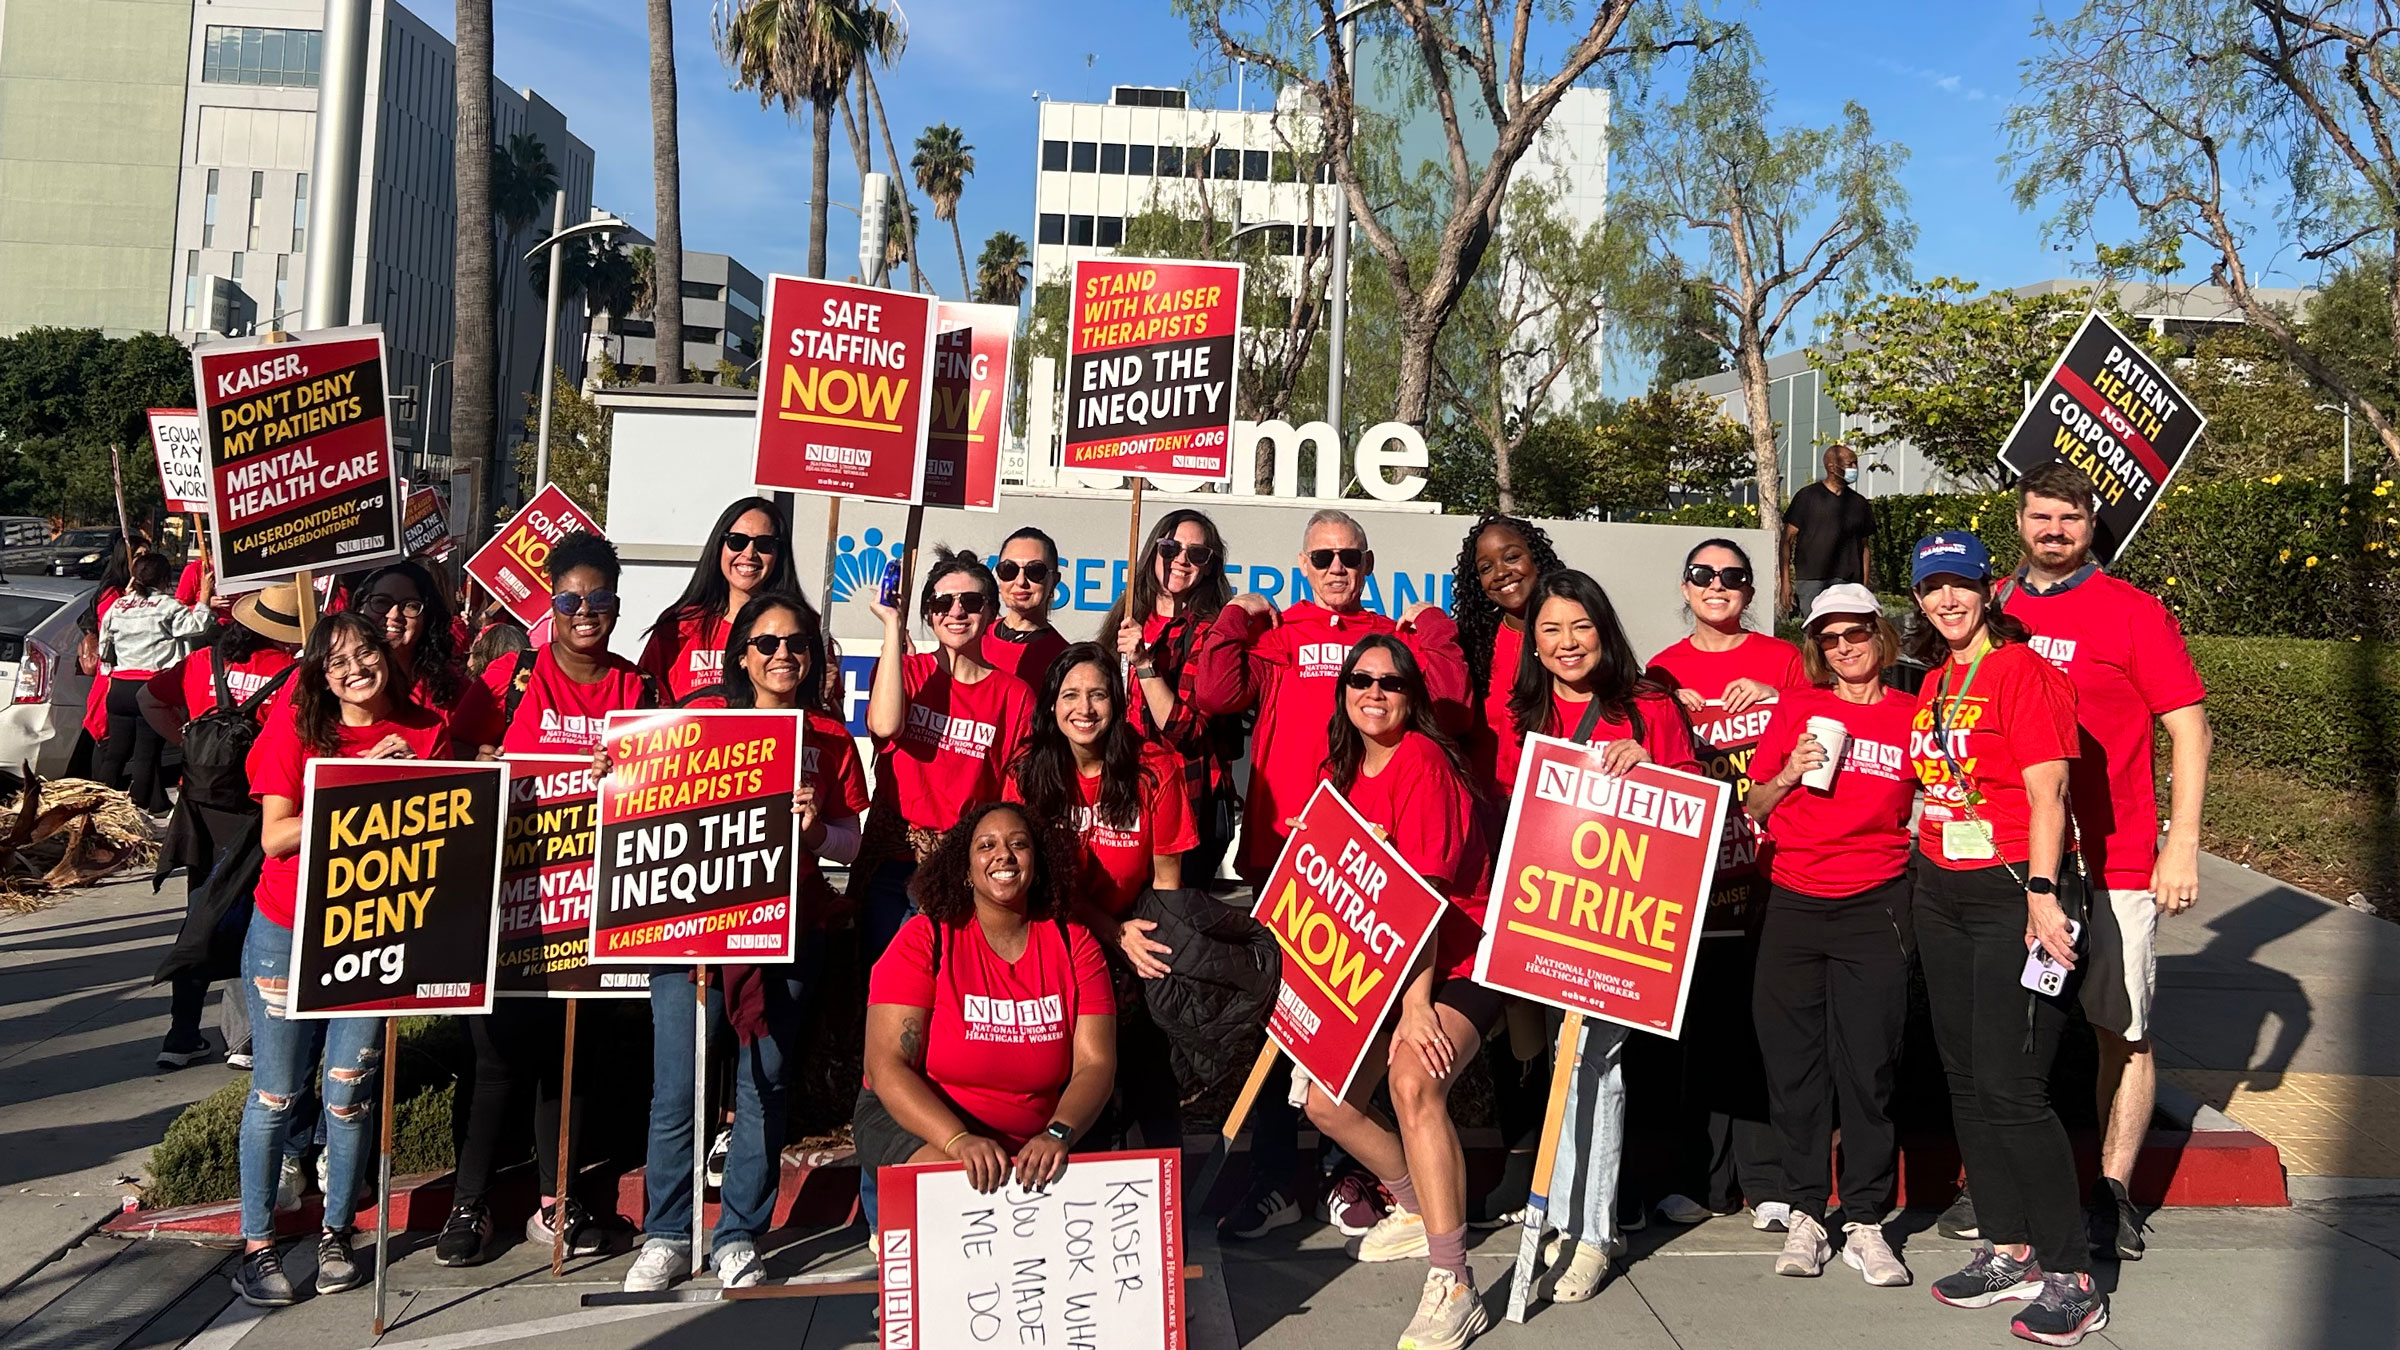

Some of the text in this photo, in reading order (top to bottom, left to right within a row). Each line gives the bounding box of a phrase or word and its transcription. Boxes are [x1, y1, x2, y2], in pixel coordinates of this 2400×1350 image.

[1085, 269, 1157, 299] STAND
[821, 298, 882, 333] SAFE
[1084, 286, 1222, 325] WITH KAISER
[789, 328, 906, 370] STAFFING
[1081, 312, 1209, 349] THERAPISTS
[217, 353, 309, 398] KAISER,
[934, 352, 989, 381] FING
[1082, 346, 1211, 392] END THE
[2104, 345, 2179, 422] PATIENT
[221, 370, 356, 433] DON'T DENY
[780, 364, 910, 421] NOW
[1077, 381, 1225, 429] INEQUITY
[2093, 368, 2163, 442] HEALTH
[223, 396, 362, 460] MY PATIENTS
[2100, 406, 2135, 440] NOT
[171, 443, 202, 463] PAY
[805, 443, 872, 467] NUHW
[1075, 431, 1225, 462] KAISERDONTDENY.ORG
[1172, 455, 1220, 470] NUHW
[2050, 393, 2152, 501] CORPORATE
[2053, 425, 2126, 507] WEALTH
[163, 462, 202, 478] EQUA
[226, 446, 319, 495] MENTAL
[229, 451, 379, 521] HEALTH CARE
[817, 478, 855, 489] nuhw.org
[233, 494, 384, 554] KAISERDONTDENY.org
[260, 513, 361, 559] #KAISERDONTDENY
[336, 535, 385, 555] NUHW
[405, 513, 440, 542] END THE
[408, 521, 446, 552] INEQUITY
[527, 510, 565, 544] CONT
[1299, 643, 1354, 666] NU
[2028, 635, 2076, 662] HW
[540, 708, 606, 735] NUH
[618, 722, 702, 759] STAND
[908, 703, 997, 747] NUHW
[616, 753, 681, 788] WITH
[686, 737, 777, 777] KAISER
[1843, 737, 1903, 770] HW
[614, 768, 763, 818] THERAPISTS
[1535, 759, 1706, 838] NUHW
[329, 788, 475, 850] KAISER
[507, 805, 582, 840] DON'T
[616, 806, 767, 868] END THE
[503, 831, 595, 868] MY PATI
[1099, 837, 1139, 848] WORKERS
[1571, 820, 1649, 882] ON
[327, 838, 445, 899] DONT
[501, 867, 594, 905] MENTAL
[610, 845, 784, 912] INEQUITY
[1337, 837, 1388, 904] FAIR
[323, 886, 436, 948] DENY
[499, 895, 591, 933] HEALTH
[1295, 843, 1406, 965] CONTRACT
[1513, 864, 1683, 952] STRIKE
[608, 902, 786, 950] KAISERDONTDENY.ORG
[727, 934, 782, 949] NUHW
[1271, 877, 1385, 1007] NOW
[320, 944, 405, 986] .org
[497, 938, 589, 967] KAISERDONT
[522, 957, 589, 977] #KAISERDO
[1534, 954, 1635, 989] NATIONAL UNION OF
[416, 983, 470, 998] NUHW
[1525, 962, 1640, 1001] HEALTHCARE WORKERS
[1562, 990, 1605, 1009] nuhw.org
[964, 994, 1063, 1026] NUHW
[972, 1022, 1018, 1034] NATIONAL
[1020, 1025, 1047, 1035] UNION
[1278, 979, 1322, 1036] UHW
[965, 1030, 1025, 1043] HEALTHCARE
[1163, 1158, 1174, 1209] NATIONAL
[1064, 1201, 1097, 1281] LOOK
[1104, 1179, 1153, 1304] KAISER
[1164, 1210, 1175, 1245] UNION
[884, 1229, 912, 1350] NUHW
[961, 1208, 1001, 1342] ME DO
[1012, 1258, 1047, 1346] MADE
